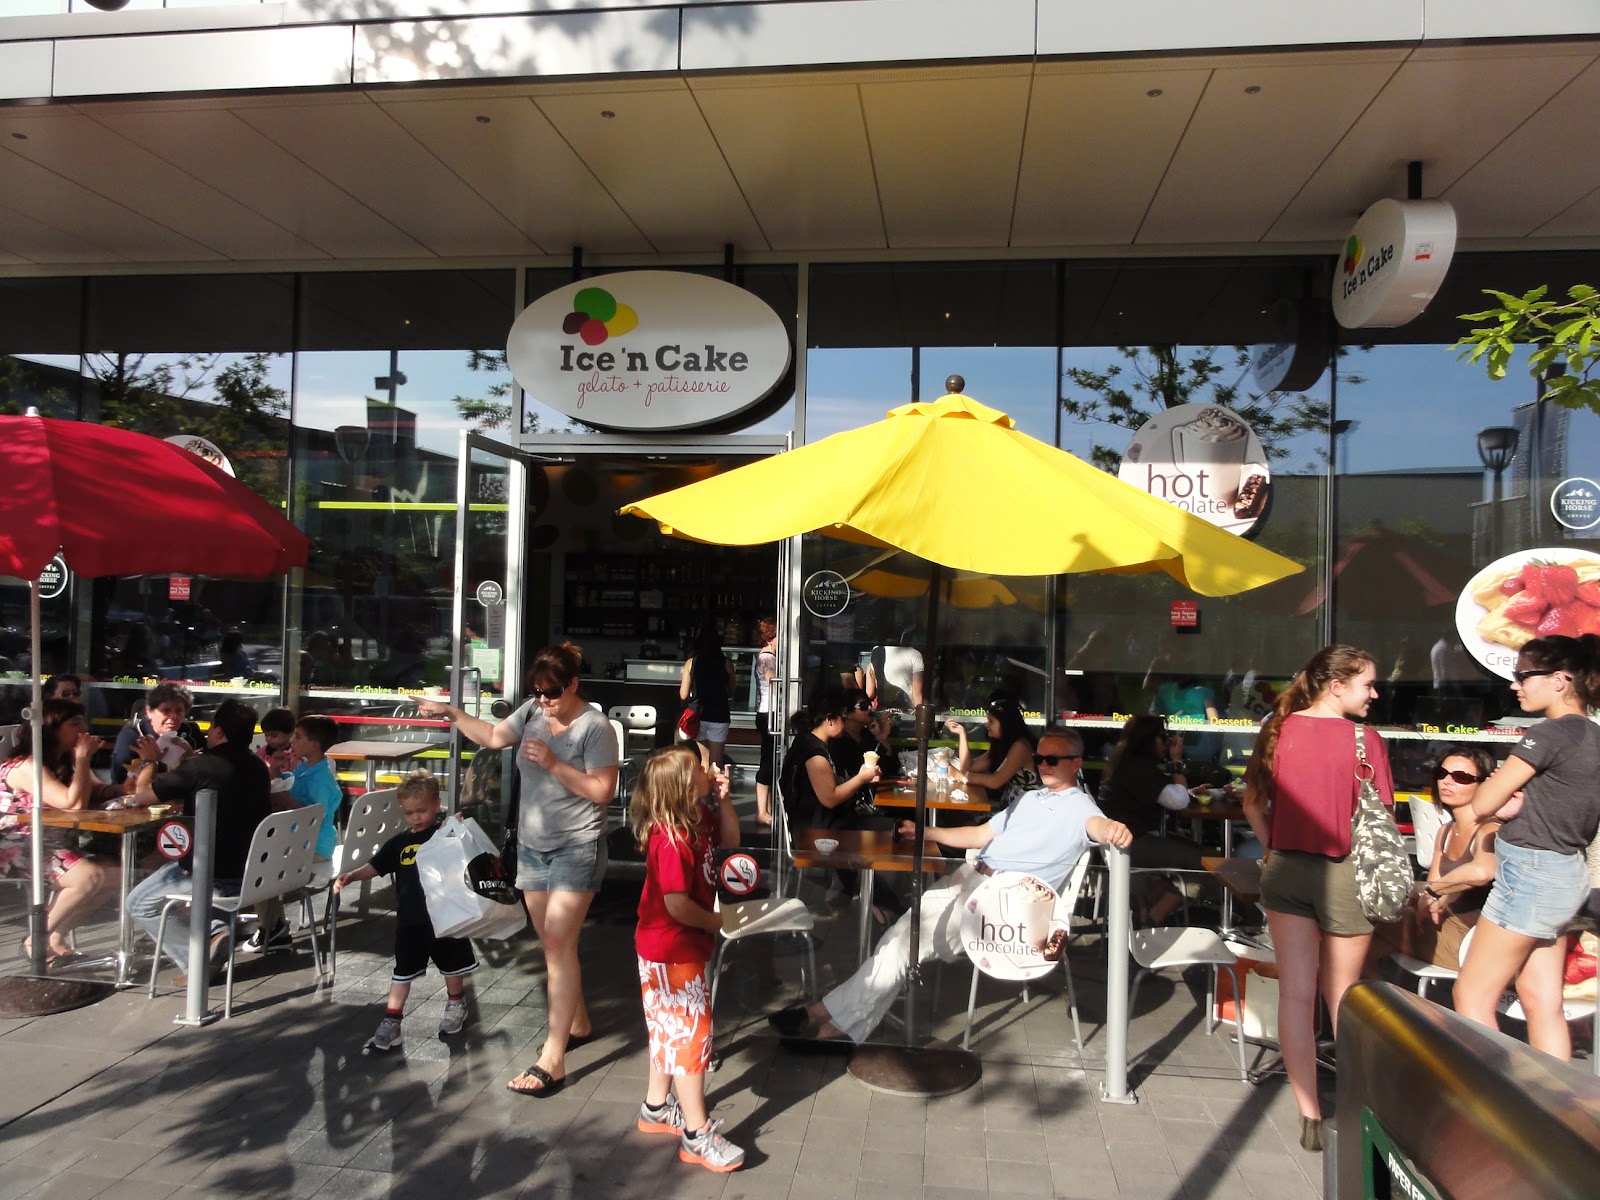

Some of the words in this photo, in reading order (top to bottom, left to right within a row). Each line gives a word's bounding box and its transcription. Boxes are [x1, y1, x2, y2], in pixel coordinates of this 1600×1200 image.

[1343, 275, 1358, 300] Ice
[1367, 244, 1394, 278] Cake
[560, 345, 616, 372] Ice
[655, 344, 749, 372] Cake
[577, 371, 630, 409] gelato
[644, 375, 731, 408] patisserie
[1147, 463, 1210, 499] hot
[1560, 498, 1597, 506] KICKING
[1564, 504, 1594, 512] HORSE
[811, 589, 842, 597] KICKING
[1485, 652, 1520, 670] Crep
[112, 675, 138, 684] Coffee
[142, 676, 157, 686] Tea
[249, 680, 274, 690] Cakes
[354, 684, 393, 695] G-Shakes
[1210, 716, 1253, 727] Desserts
[1420, 723, 1440, 734] Tea
[1446, 724, 1480, 735] Cakes
[981, 914, 1026, 944] hot
[968, 937, 1039, 956] chocolate
[1388, 1151, 1412, 1196] PAPER
